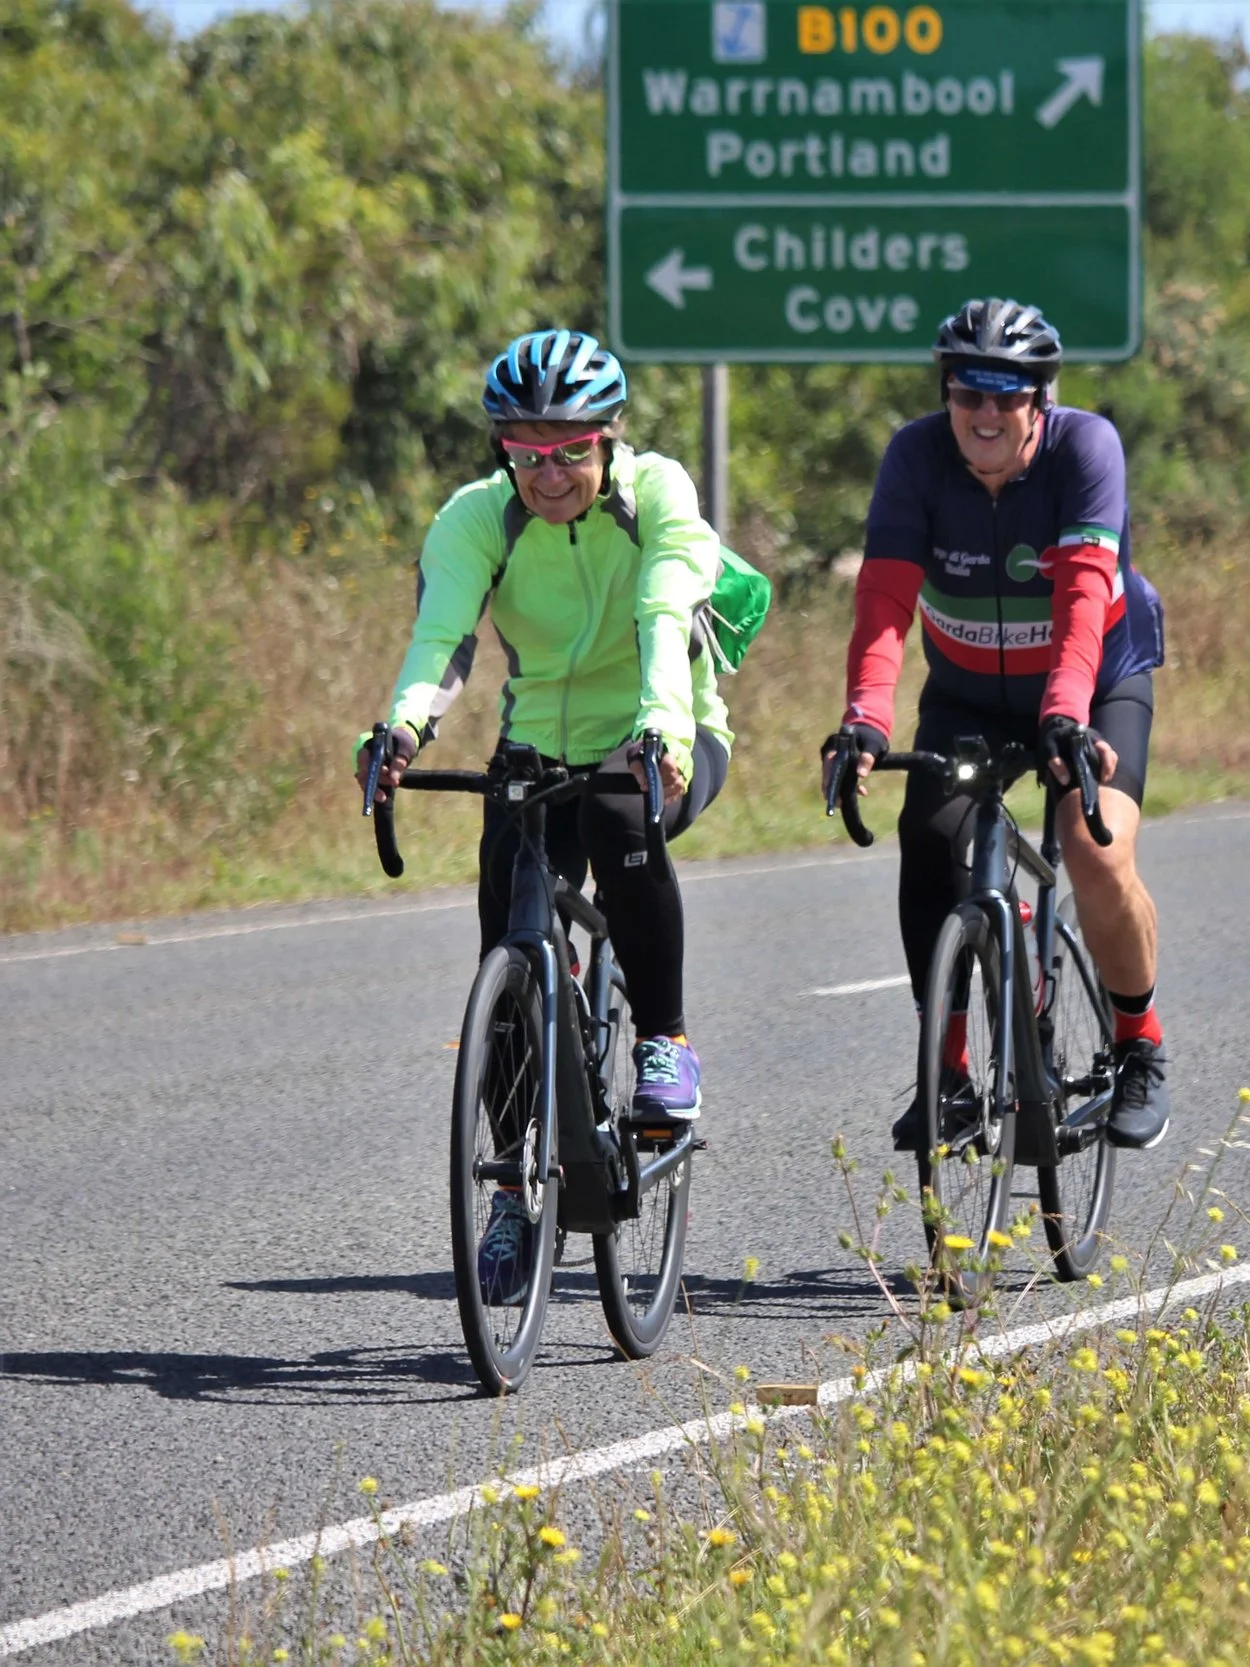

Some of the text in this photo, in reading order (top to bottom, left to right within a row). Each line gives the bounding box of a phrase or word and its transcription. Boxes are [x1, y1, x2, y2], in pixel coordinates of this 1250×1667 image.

[798, 6, 943, 54] B100
[643, 70, 1014, 115] Warrnambool
[706, 132, 950, 177] Portland
[733, 225, 969, 272] Childers
[785, 287, 918, 332] Cove
